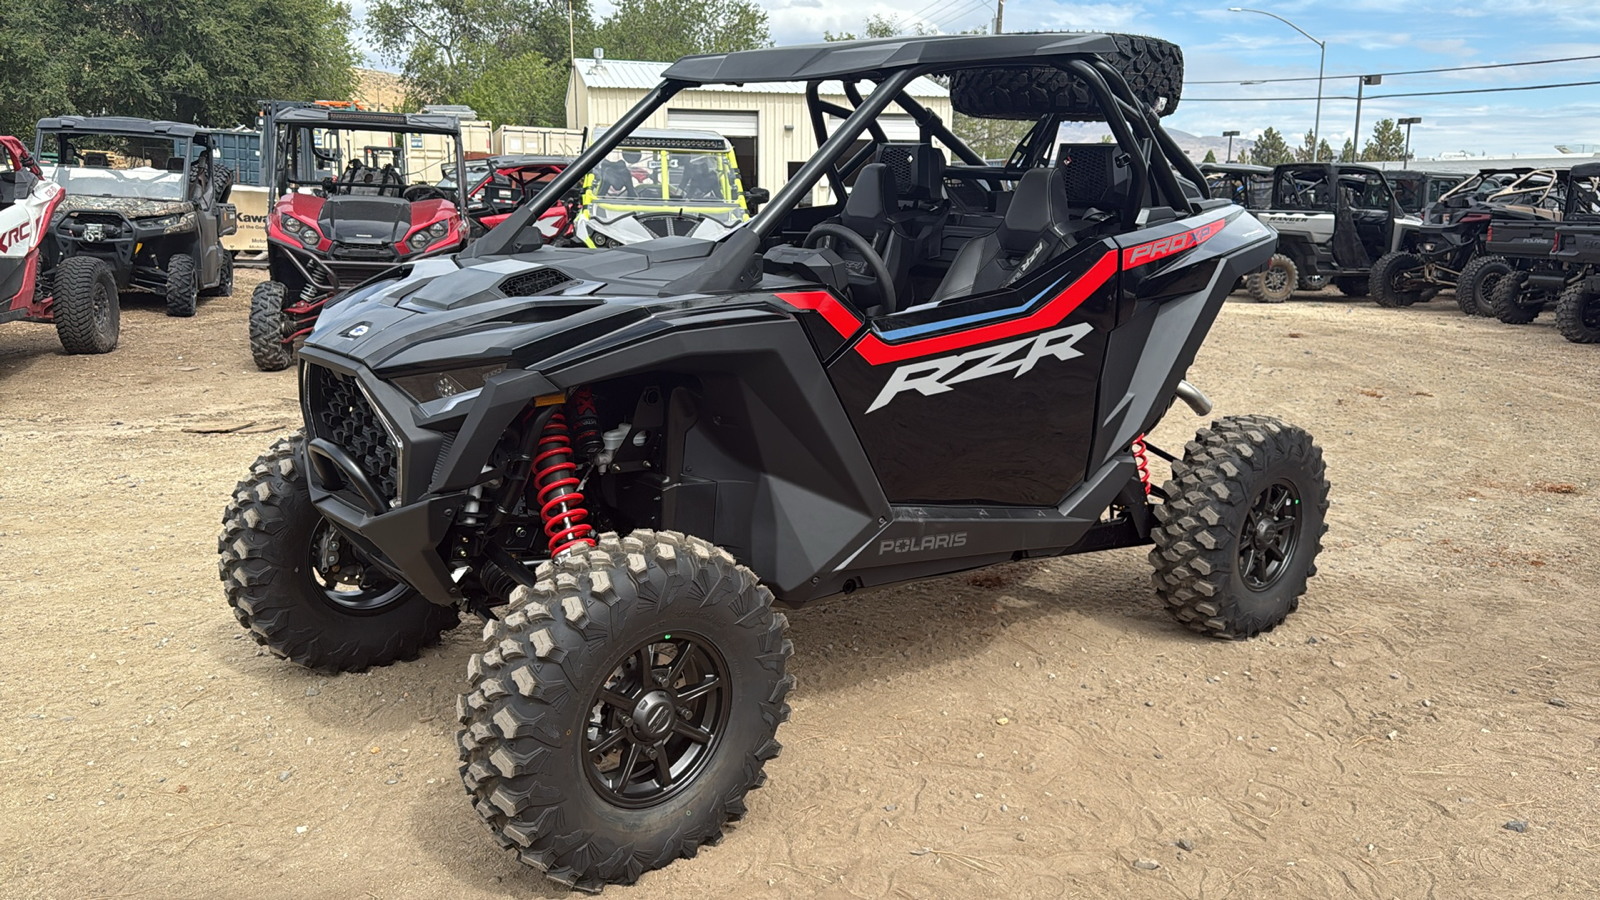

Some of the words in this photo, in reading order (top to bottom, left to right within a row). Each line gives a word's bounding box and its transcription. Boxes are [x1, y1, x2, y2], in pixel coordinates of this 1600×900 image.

[1129, 234, 1188, 264] PRO
[1188, 226, 1210, 246] XP
[864, 322, 1094, 415] RZR
[879, 532, 968, 556] POLARIS
